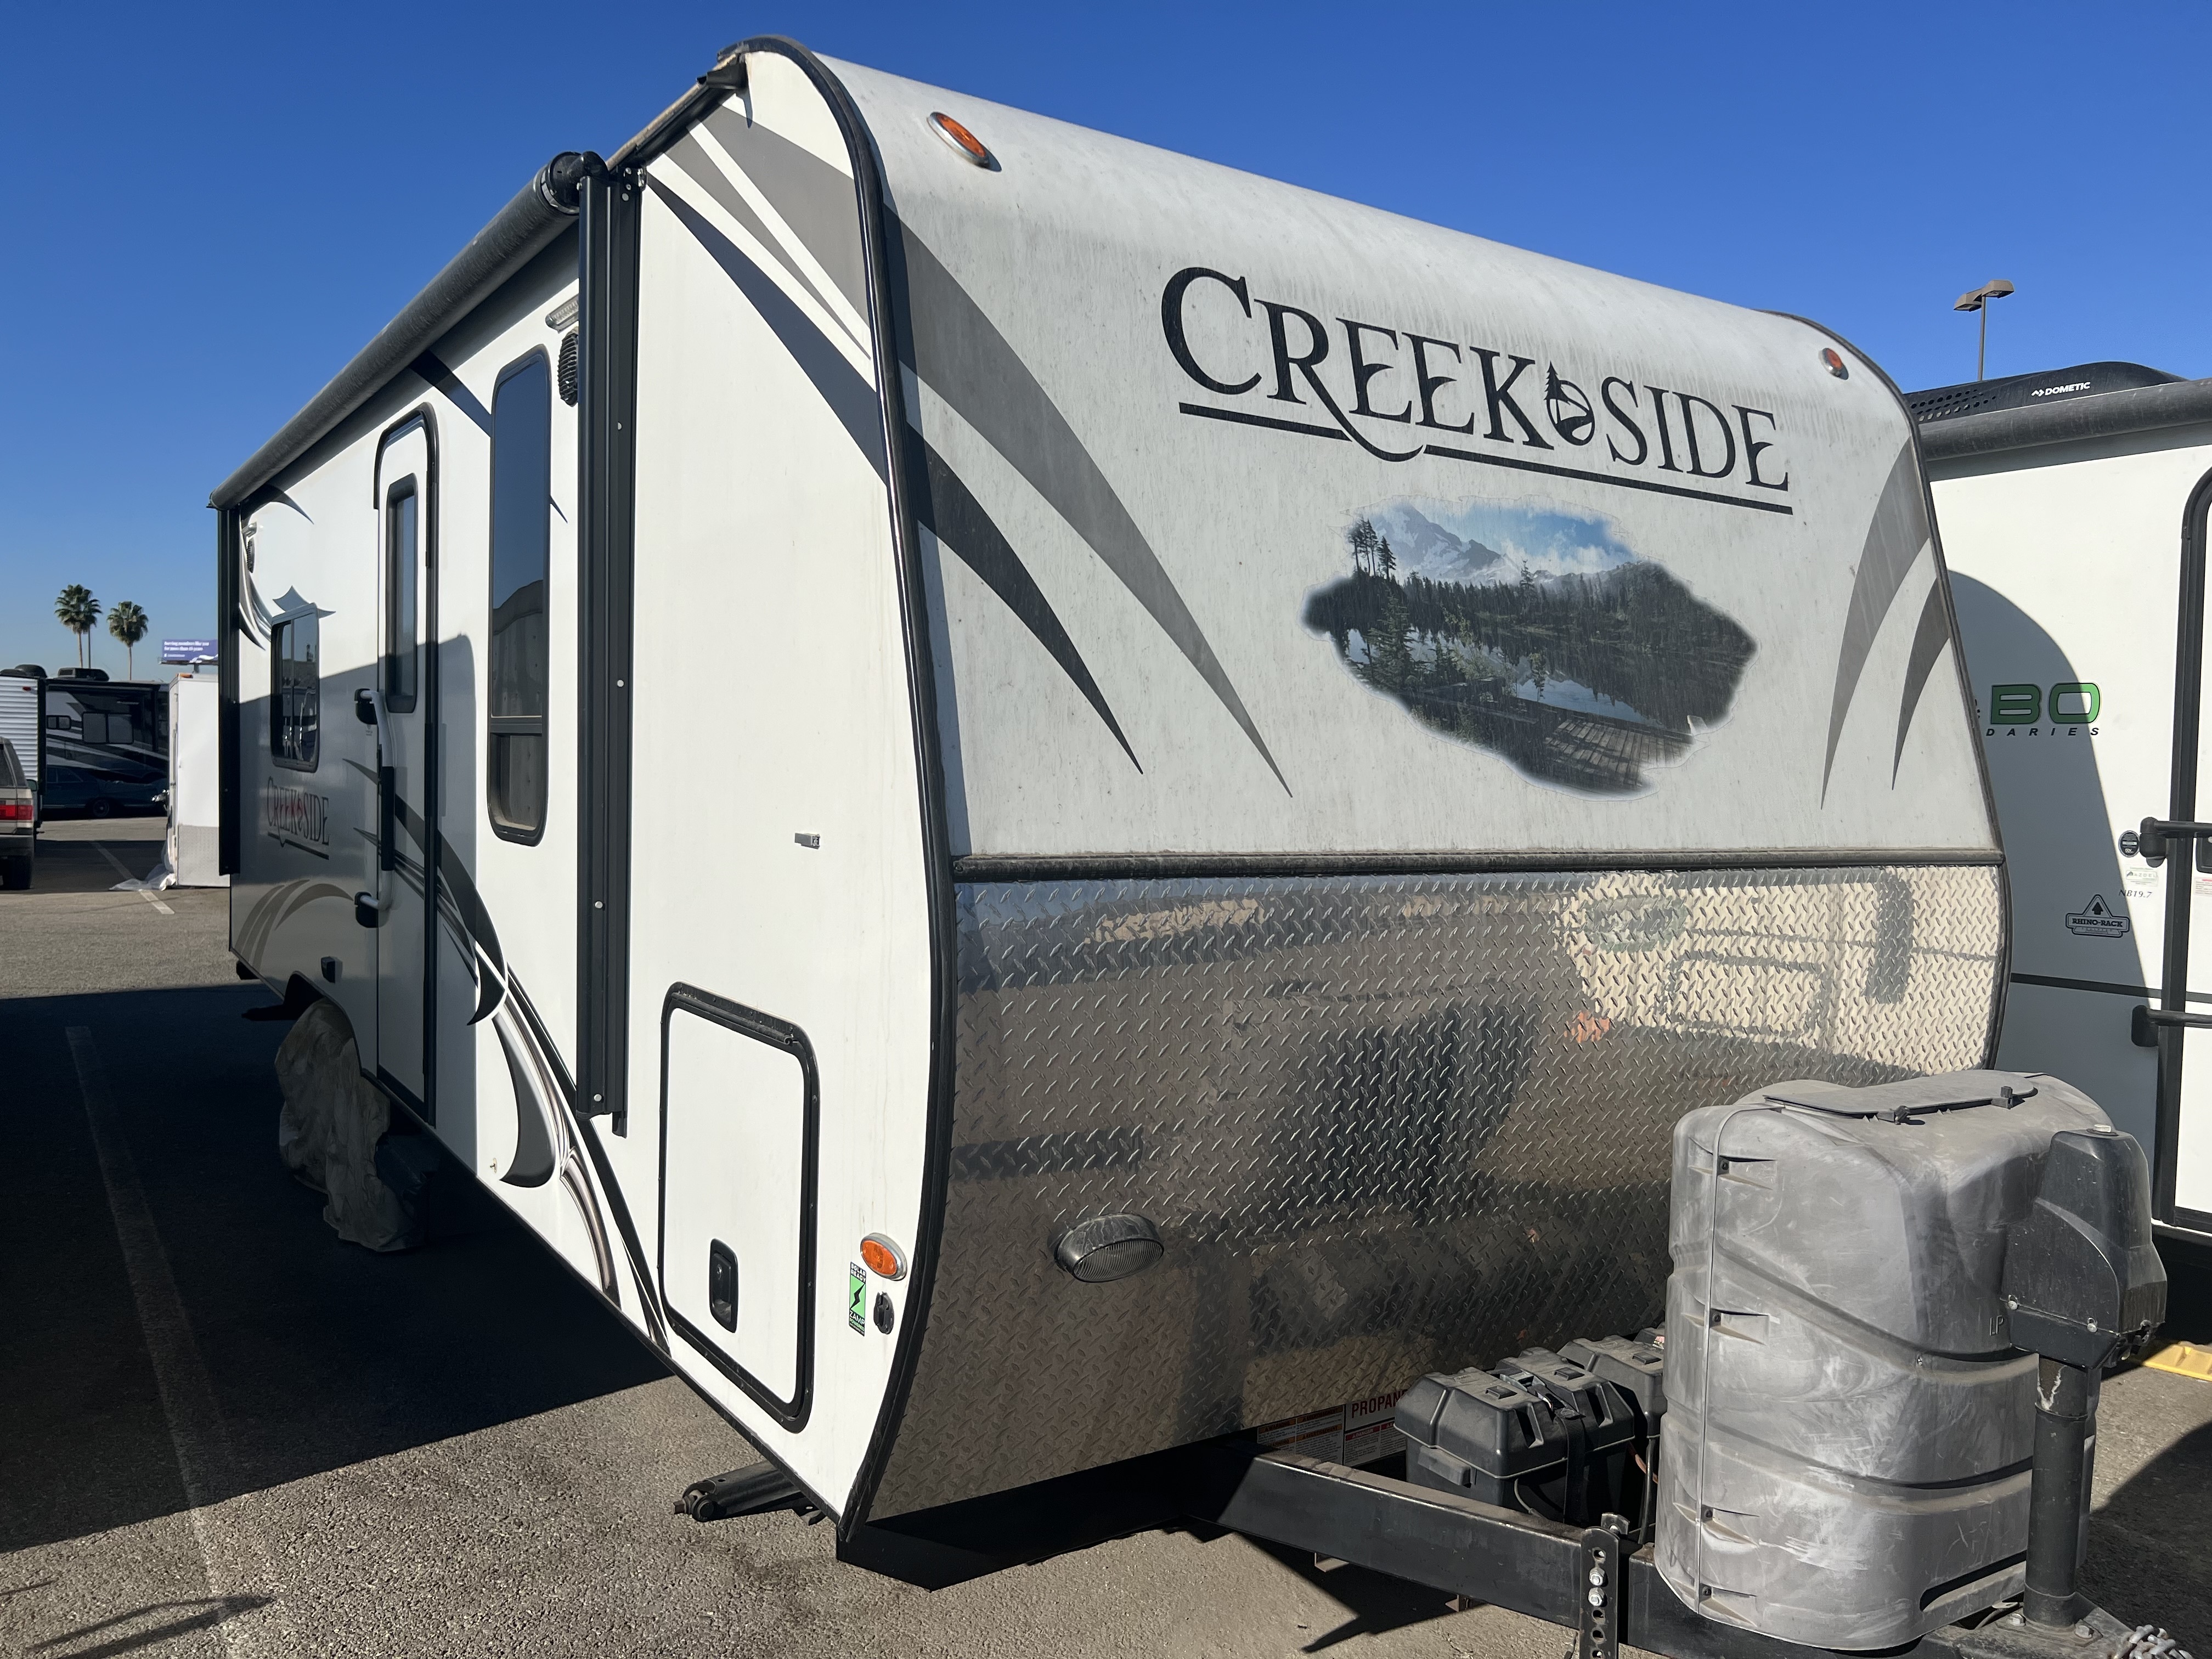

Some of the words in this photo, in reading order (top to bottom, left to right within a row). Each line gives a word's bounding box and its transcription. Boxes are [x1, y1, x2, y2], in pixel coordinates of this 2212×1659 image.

[2045, 382, 2091, 396] DOMETIC
[1990, 682, 2101, 725] BO
[1985, 727, 2100, 737] DARIES
[2118, 889, 2153, 899] NB19.7
[2072, 918, 2123, 928] RHINO-RACK
[850, 1268, 866, 1283] READY
[851, 1263, 866, 1277] SOLAR
[849, 1310, 865, 1325] ZAMP
[1989, 1314, 2004, 1336] LP
[1351, 1389, 1408, 1419] PROPAN
